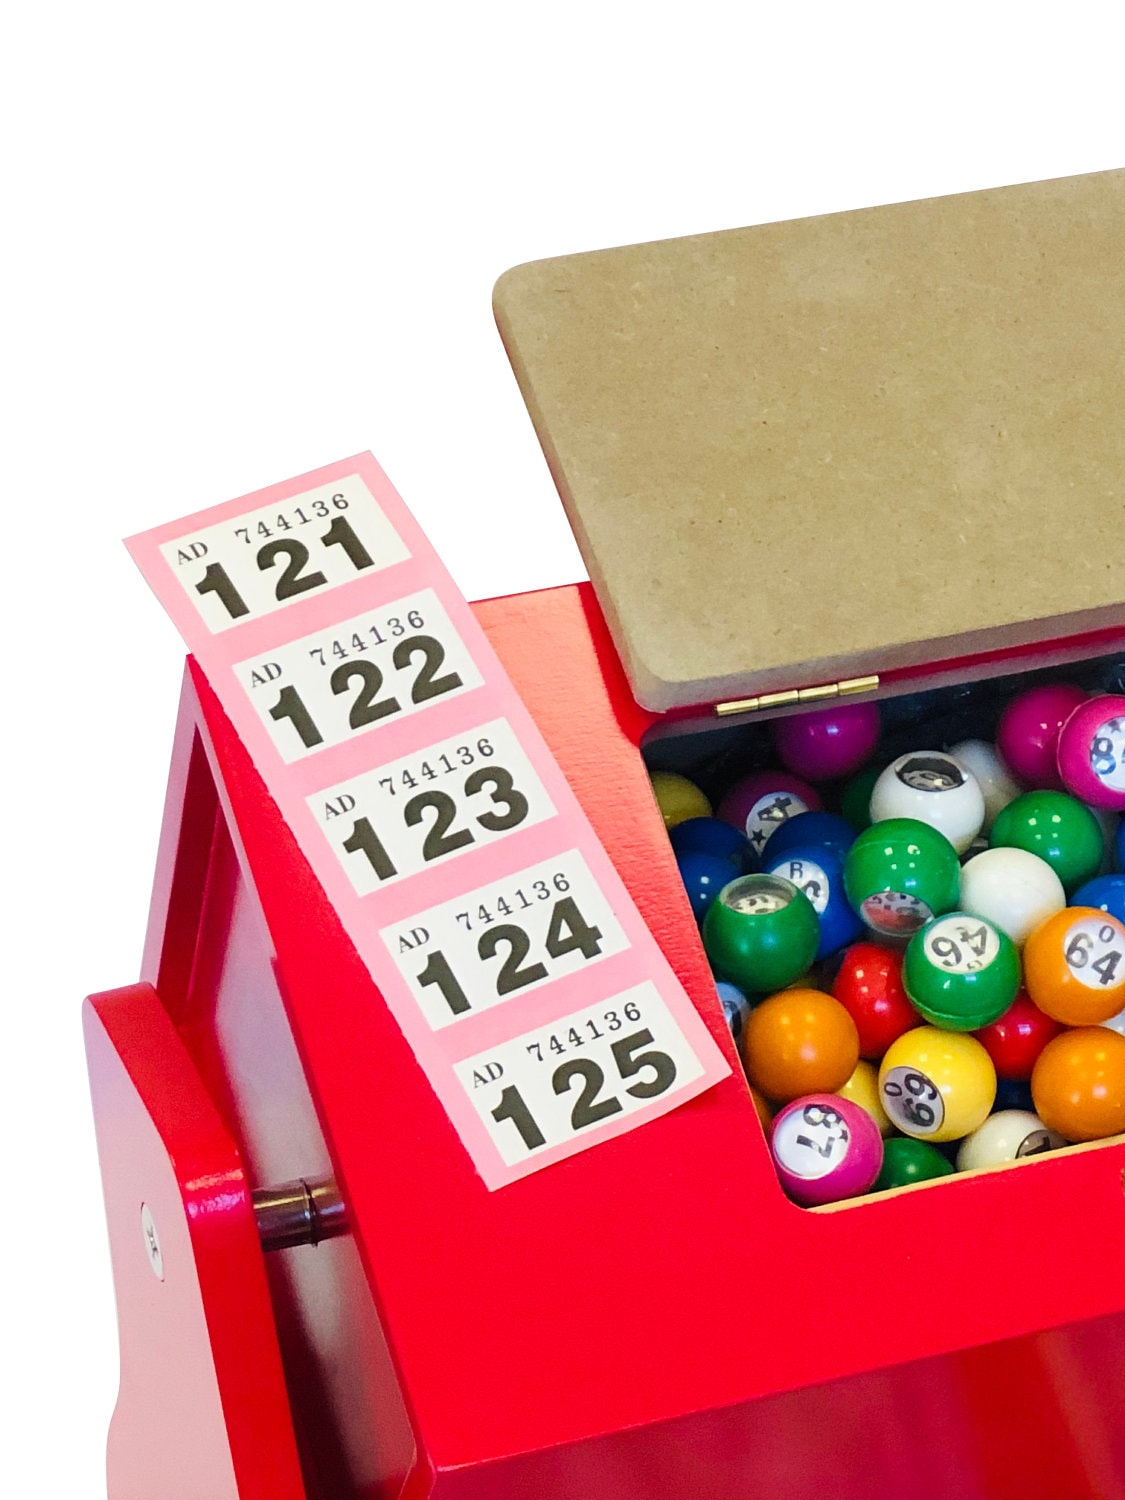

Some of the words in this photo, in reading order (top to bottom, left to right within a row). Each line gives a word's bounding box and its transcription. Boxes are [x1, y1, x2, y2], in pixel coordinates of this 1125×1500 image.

[235, 494, 348, 543] 744136
[195, 516, 375, 619] 121
[310, 611, 424, 665] 744136
[269, 635, 463, 748] 122
[323, 795, 355, 820] AD
[379, 739, 494, 795] 744136
[343, 766, 528, 881] 123
[456, 873, 569, 930] 744136
[417, 896, 603, 1015] 124
[931, 926, 989, 967] 46
[1065, 933, 1122, 986] 64
[526, 1002, 640, 1061] 744136
[491, 1028, 676, 1150] 125
[797, 1103, 836, 1160] 87
